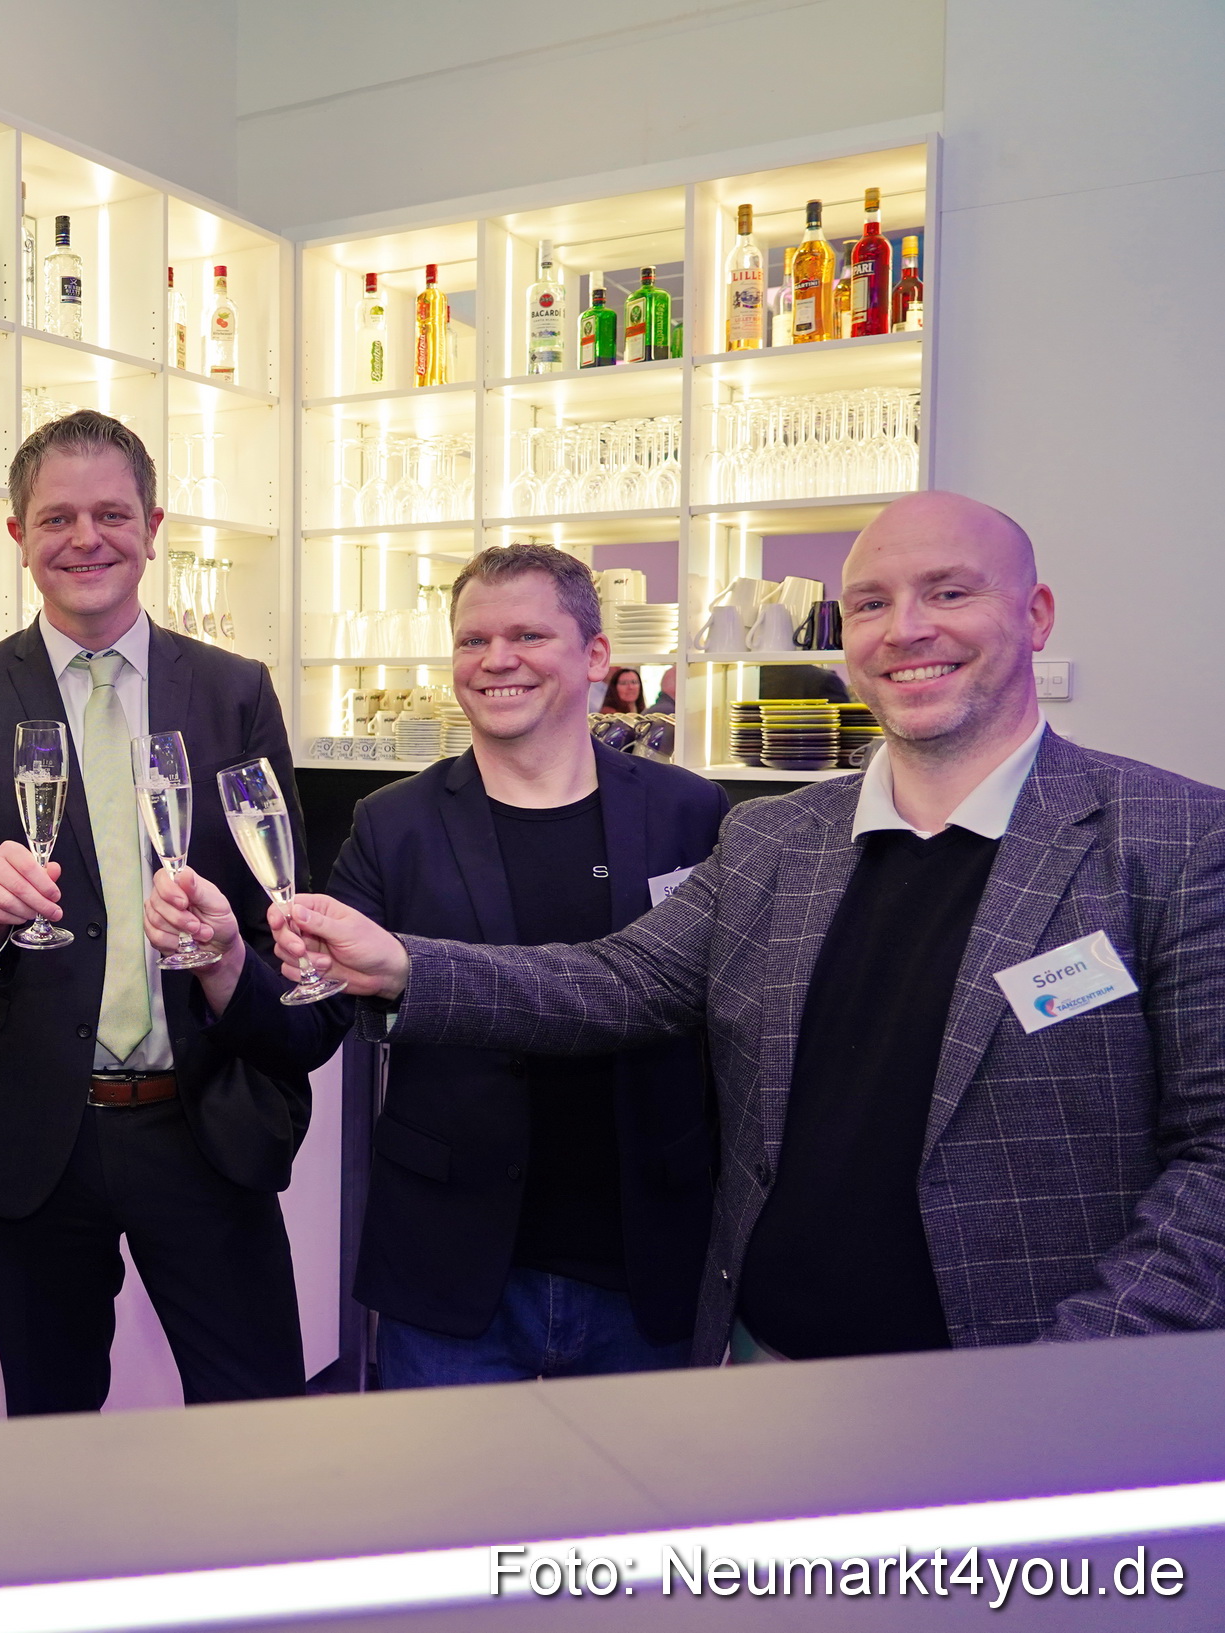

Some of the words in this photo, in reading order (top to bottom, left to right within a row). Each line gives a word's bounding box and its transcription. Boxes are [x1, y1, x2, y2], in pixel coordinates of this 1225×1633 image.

[592, 865, 609, 878] S
[1032, 961, 1088, 989] Sören
[1056, 985, 1115, 1012] TANZCENTRUM
